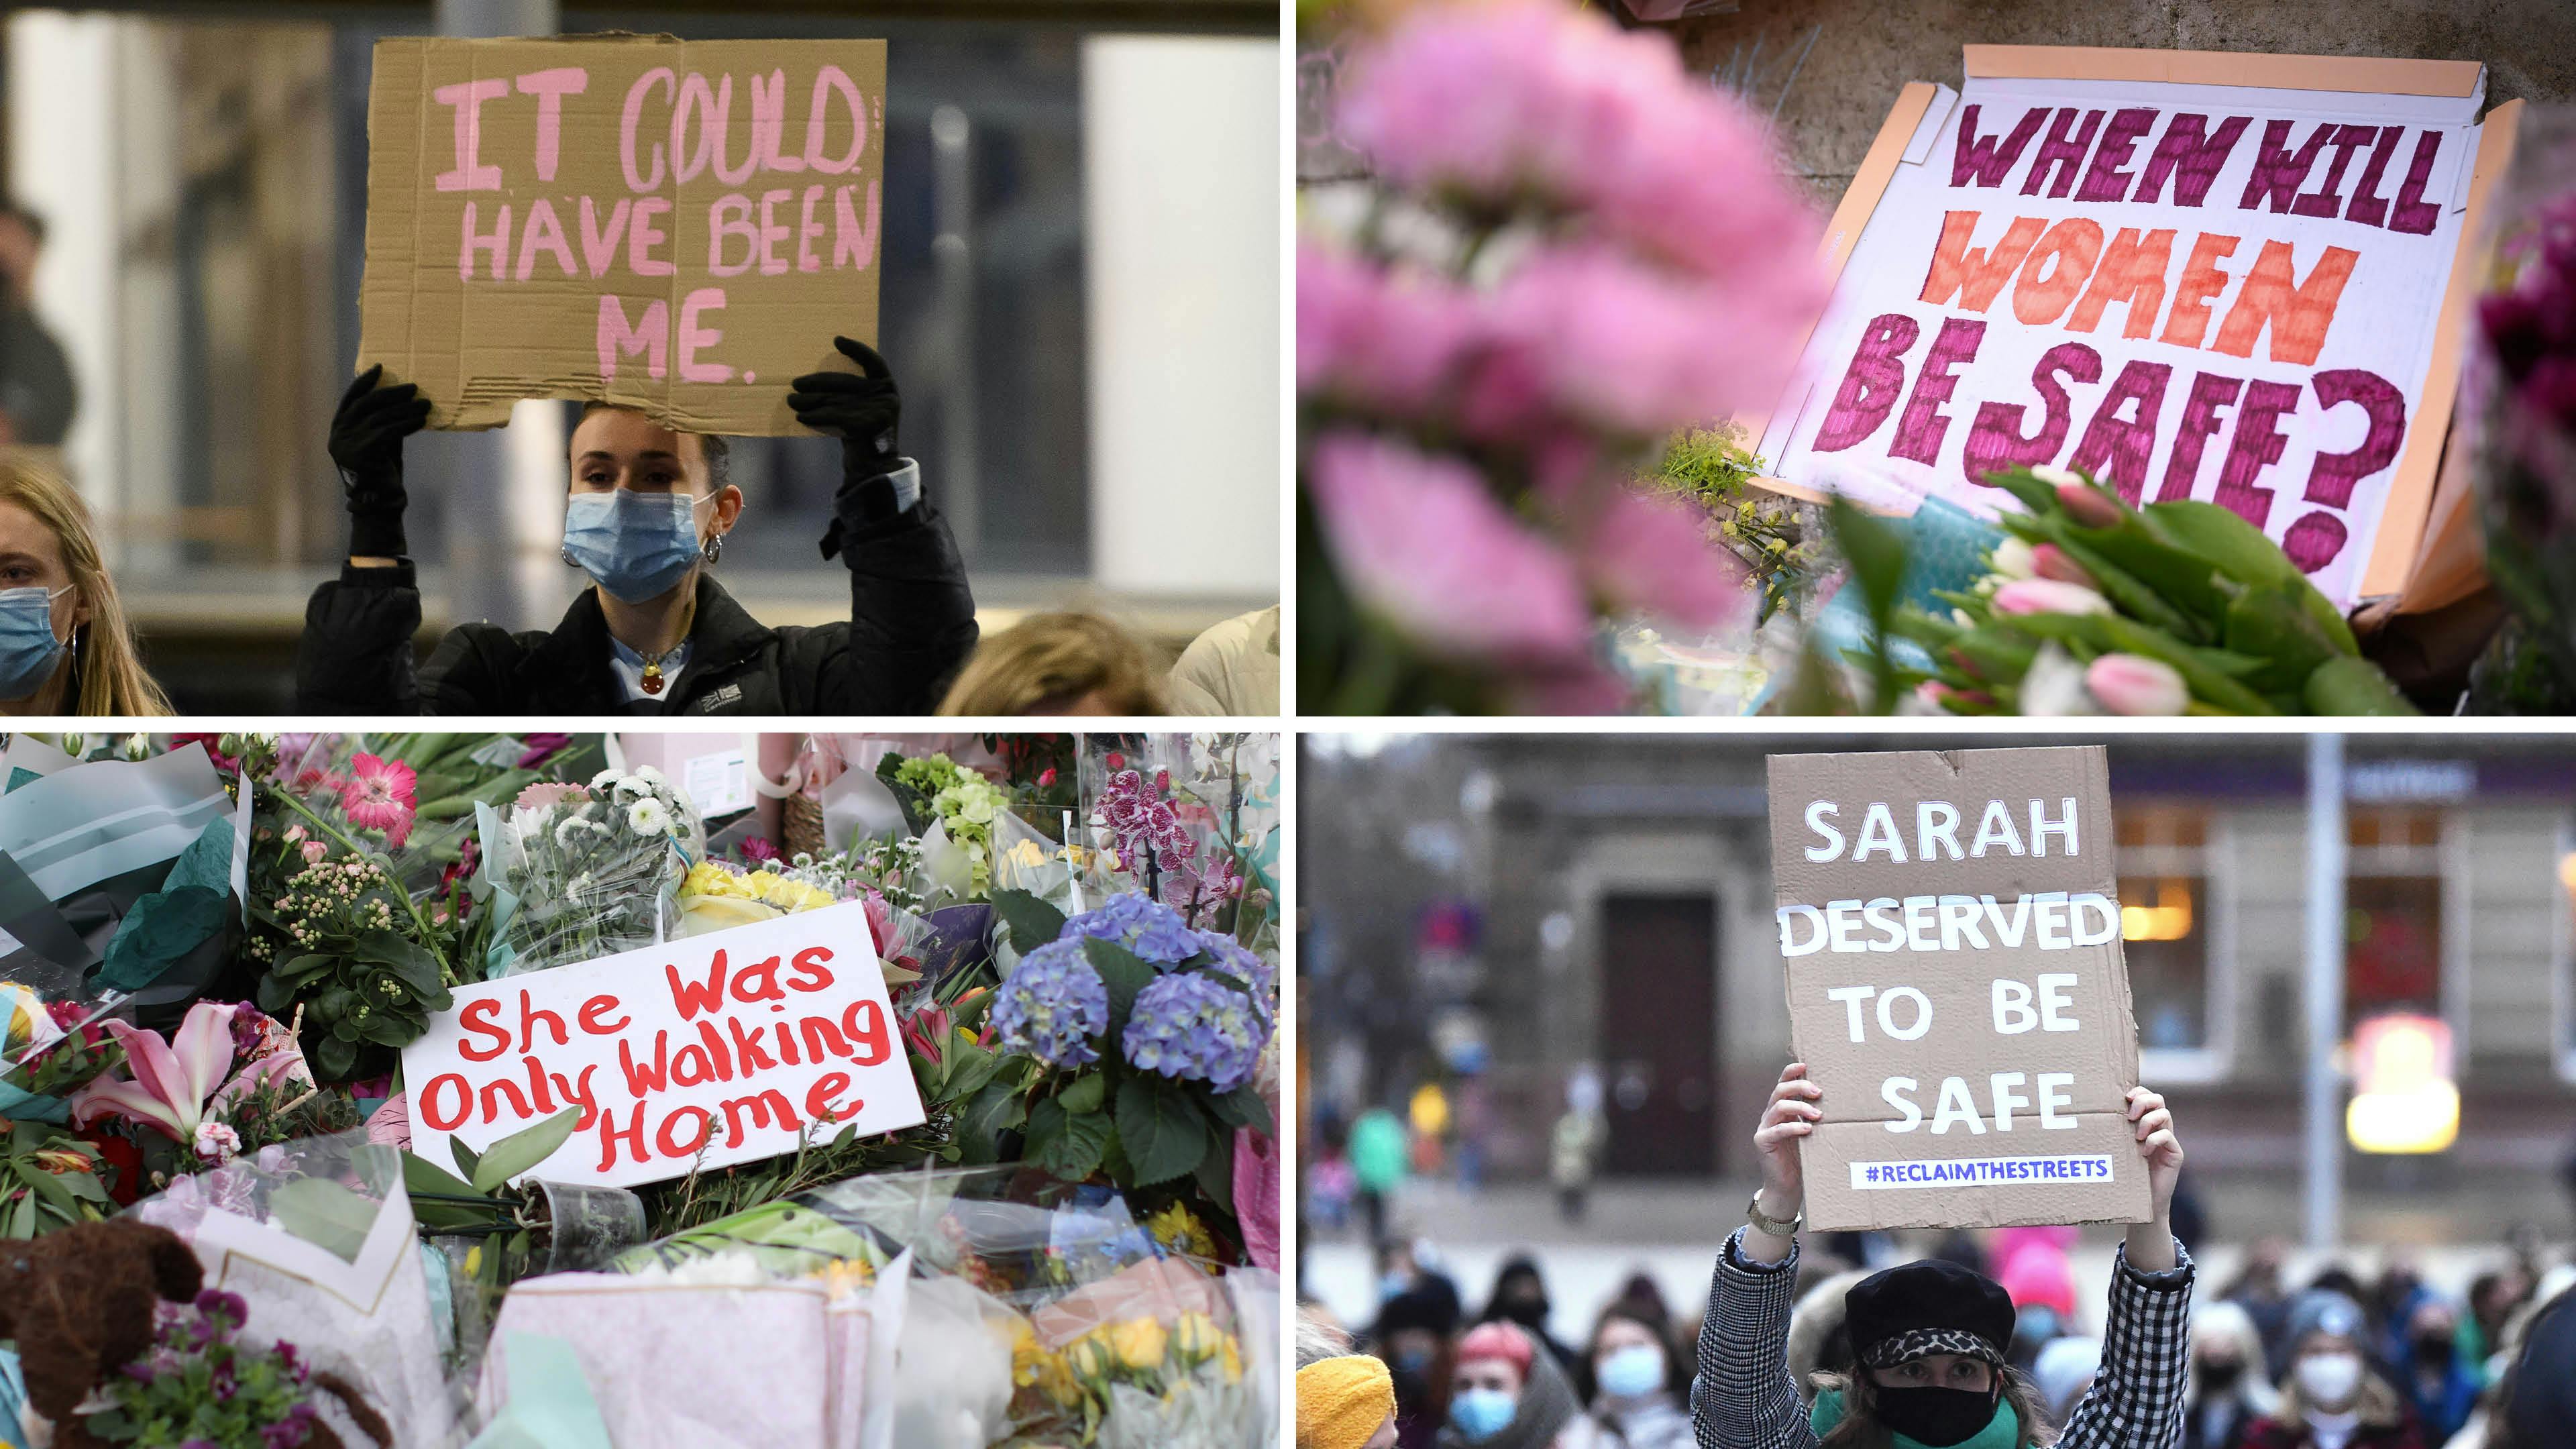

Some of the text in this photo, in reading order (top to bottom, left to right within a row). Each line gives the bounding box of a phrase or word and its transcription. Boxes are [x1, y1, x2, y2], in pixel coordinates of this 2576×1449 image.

[433, 64, 868, 194] IT COULD
[1948, 103, 2443, 236] WHEN WILL
[458, 178, 880, 284] HAVE BEEN
[595, 286, 756, 384] ME.
[1916, 209, 2361, 367] WOMEN
[1811, 313, 2407, 576] BE SAFE?
[1804, 796, 2080, 864] SARAH
[1776, 891, 2121, 958] DESERVED
[458, 946, 835, 1063] She Was
[1827, 972, 2081, 1044] TO BE
[419, 1055, 598, 1132] Only
[618, 999, 892, 1098] Walking
[1880, 1071, 2079, 1136] SAFE
[596, 1071, 865, 1173] Home
[1865, 1159, 2109, 1183] #RECLAIMTHESTREETS
